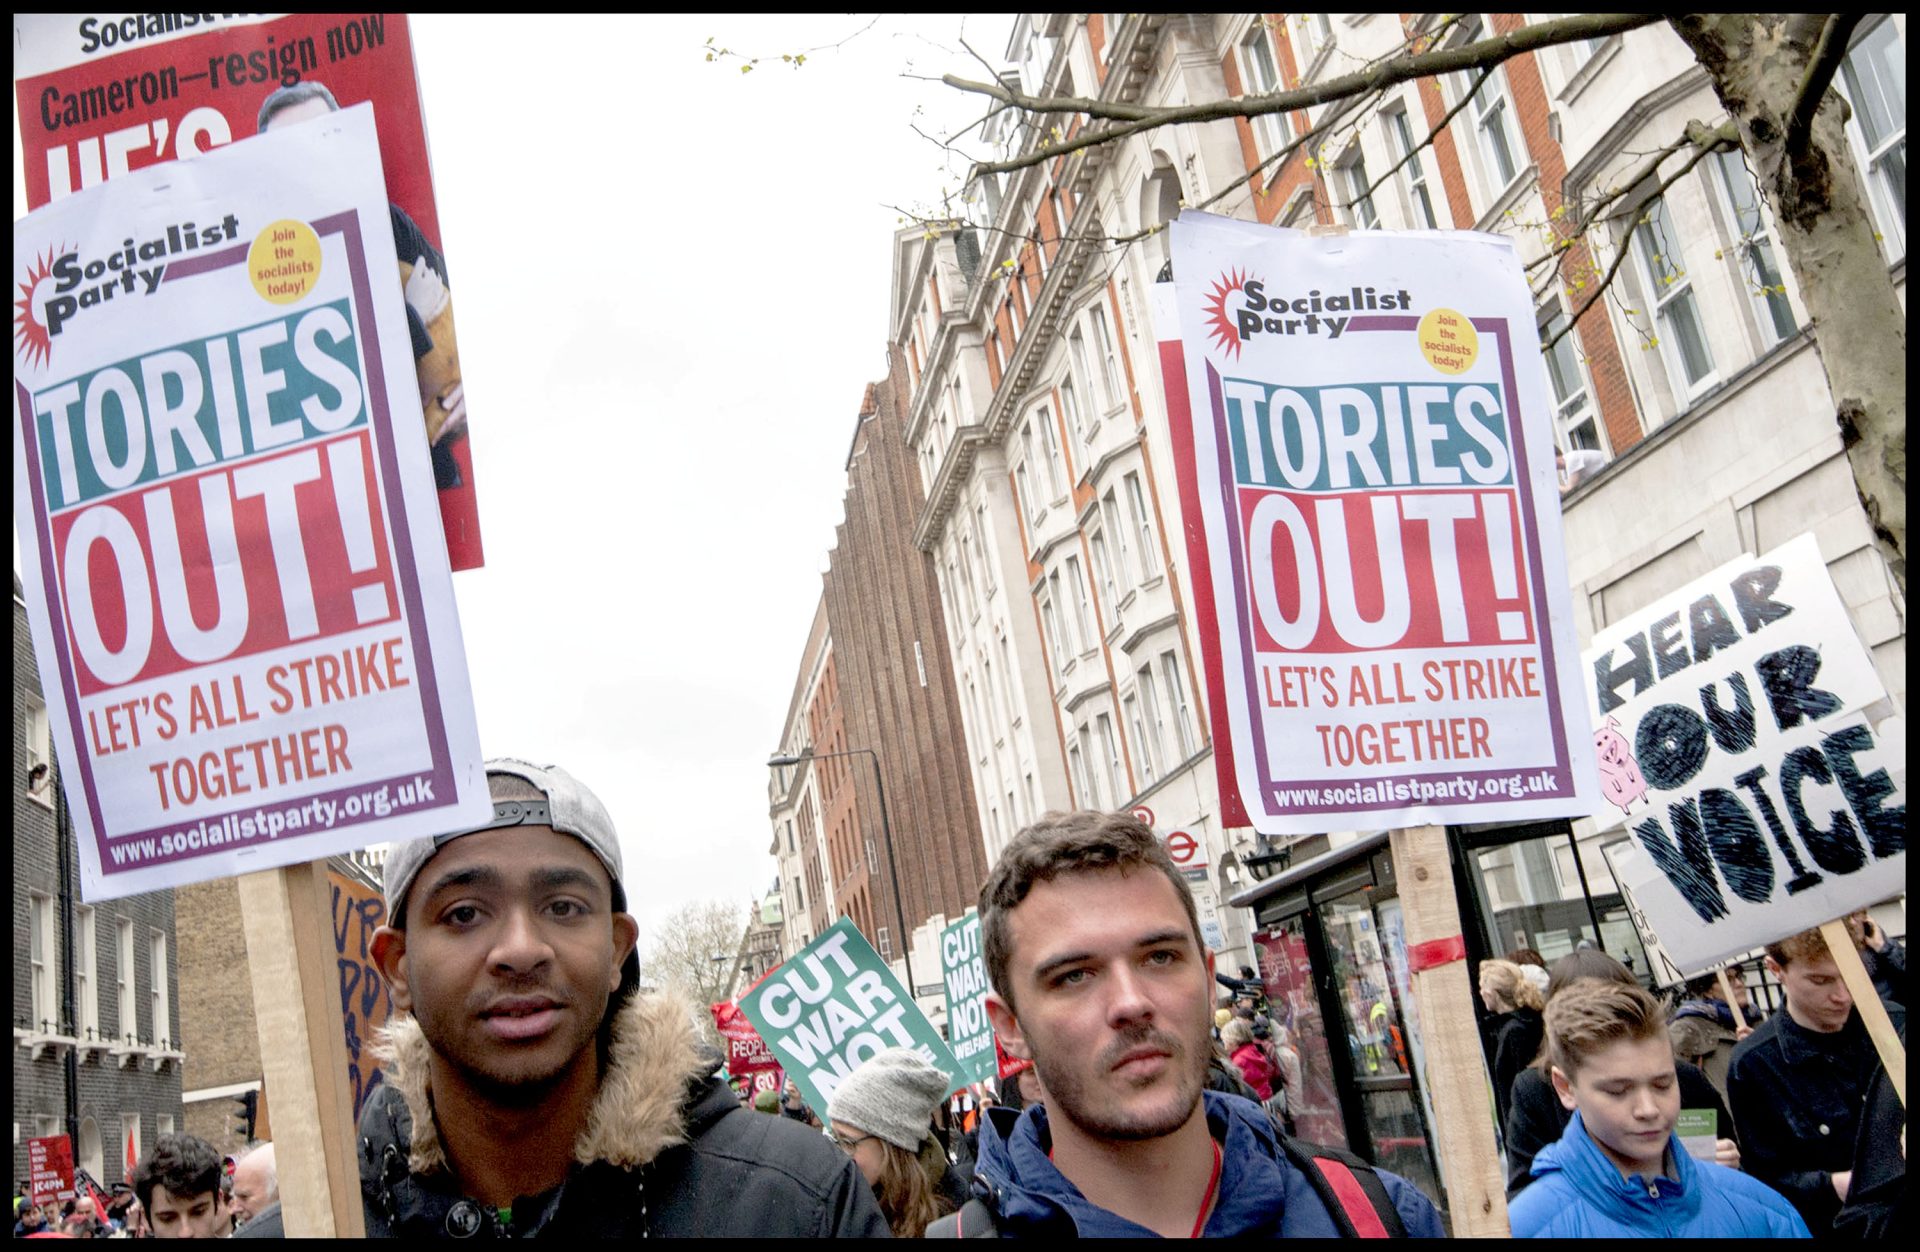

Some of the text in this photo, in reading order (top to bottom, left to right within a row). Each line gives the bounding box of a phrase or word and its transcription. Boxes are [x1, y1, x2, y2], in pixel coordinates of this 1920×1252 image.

[327, 14, 385, 63] now
[52, 214, 239, 292] Socialist
[272, 228, 296, 243] Join
[275, 247, 294, 260] the
[257, 261, 314, 281] socialists
[268, 278, 305, 296] today!
[1242, 280, 1412, 313] Socialist
[1437, 314, 1457, 327] Join
[1424, 341, 1472, 356] socialists
[1440, 328, 1456, 340] the
[1433, 354, 1464, 370] today!
[34, 306, 362, 506] TORIES
[1224, 383, 1511, 489] TORIES
[64, 436, 390, 685] OUT!
[1249, 493, 1527, 650] OUT!
[1593, 564, 1795, 717] HEAR
[88, 638, 410, 757] LET'S ALL STRIKE
[1263, 657, 1541, 709] LET'S ALL STRIKE
[1315, 717, 1493, 768] TOGETHER
[1634, 644, 1845, 791] OUR
[149, 724, 352, 811] TOGETHER
[1273, 770, 1559, 809] www.socialistparty.org.uk
[111, 776, 434, 866] www.socialistparty.org.uk
[1633, 724, 1906, 927] VOICE
[943, 918, 979, 968] CUT
[759, 930, 858, 1029] CUT
[945, 956, 985, 1003] WAR
[777, 970, 897, 1069] WAR
[952, 991, 988, 1041] NOT
[954, 1030, 991, 1060] WELFARE
